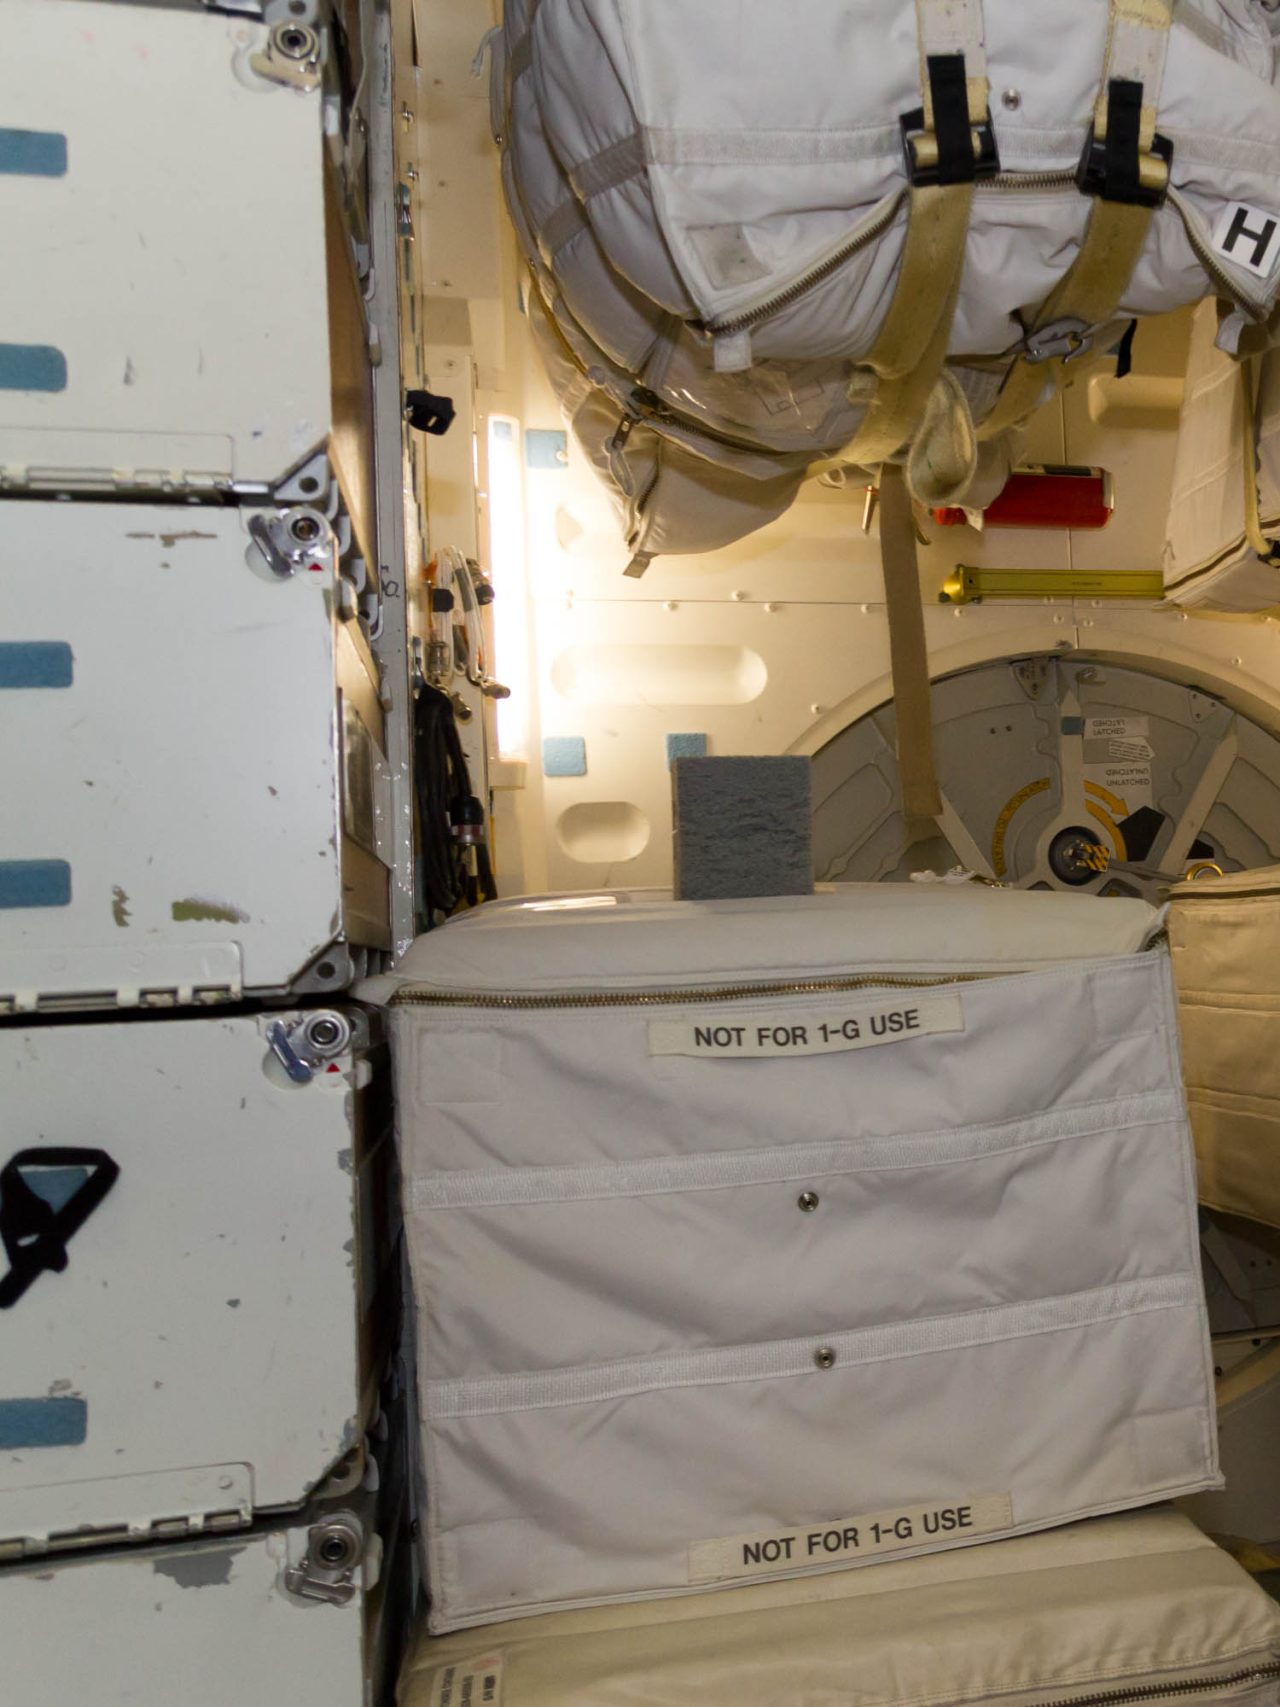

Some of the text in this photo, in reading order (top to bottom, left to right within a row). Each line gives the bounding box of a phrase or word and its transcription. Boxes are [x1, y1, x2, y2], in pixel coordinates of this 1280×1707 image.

[1222, 206, 1277, 268] H
[1093, 727, 1127, 736] LATCHED
[1106, 778, 1150, 787] UNLATCHED
[693, 1008, 920, 1047] NOT FOR 1-G USE
[743, 1506, 973, 1565] NOT FOR 1-G USE
